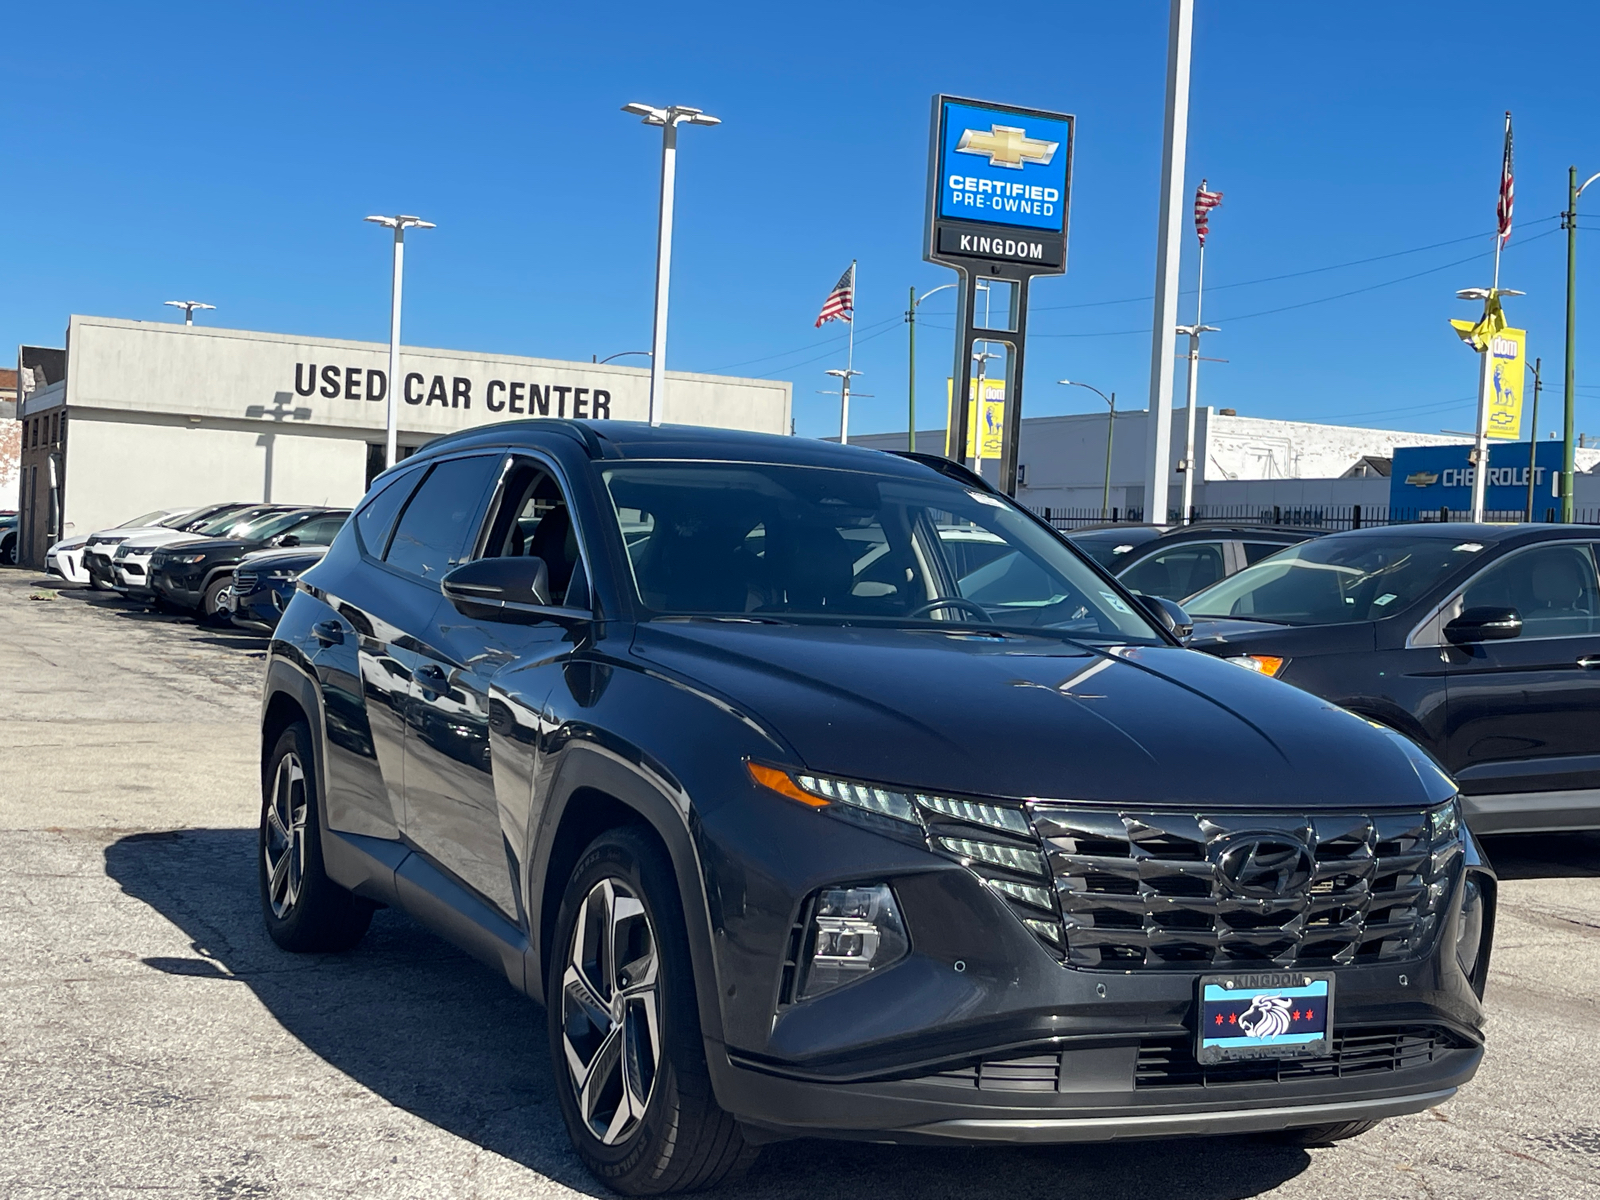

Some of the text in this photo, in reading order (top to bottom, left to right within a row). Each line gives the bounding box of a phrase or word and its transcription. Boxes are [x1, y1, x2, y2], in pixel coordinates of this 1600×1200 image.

[949, 175, 1059, 202] CERTIFIED
[953, 191, 1054, 216] PRE-OWNED
[960, 235, 1043, 259] KINGDOM
[294, 363, 611, 420] USED CAR CENTER
[1442, 467, 1546, 487] CHEROLET
[1233, 973, 1304, 988] KINGDOM
